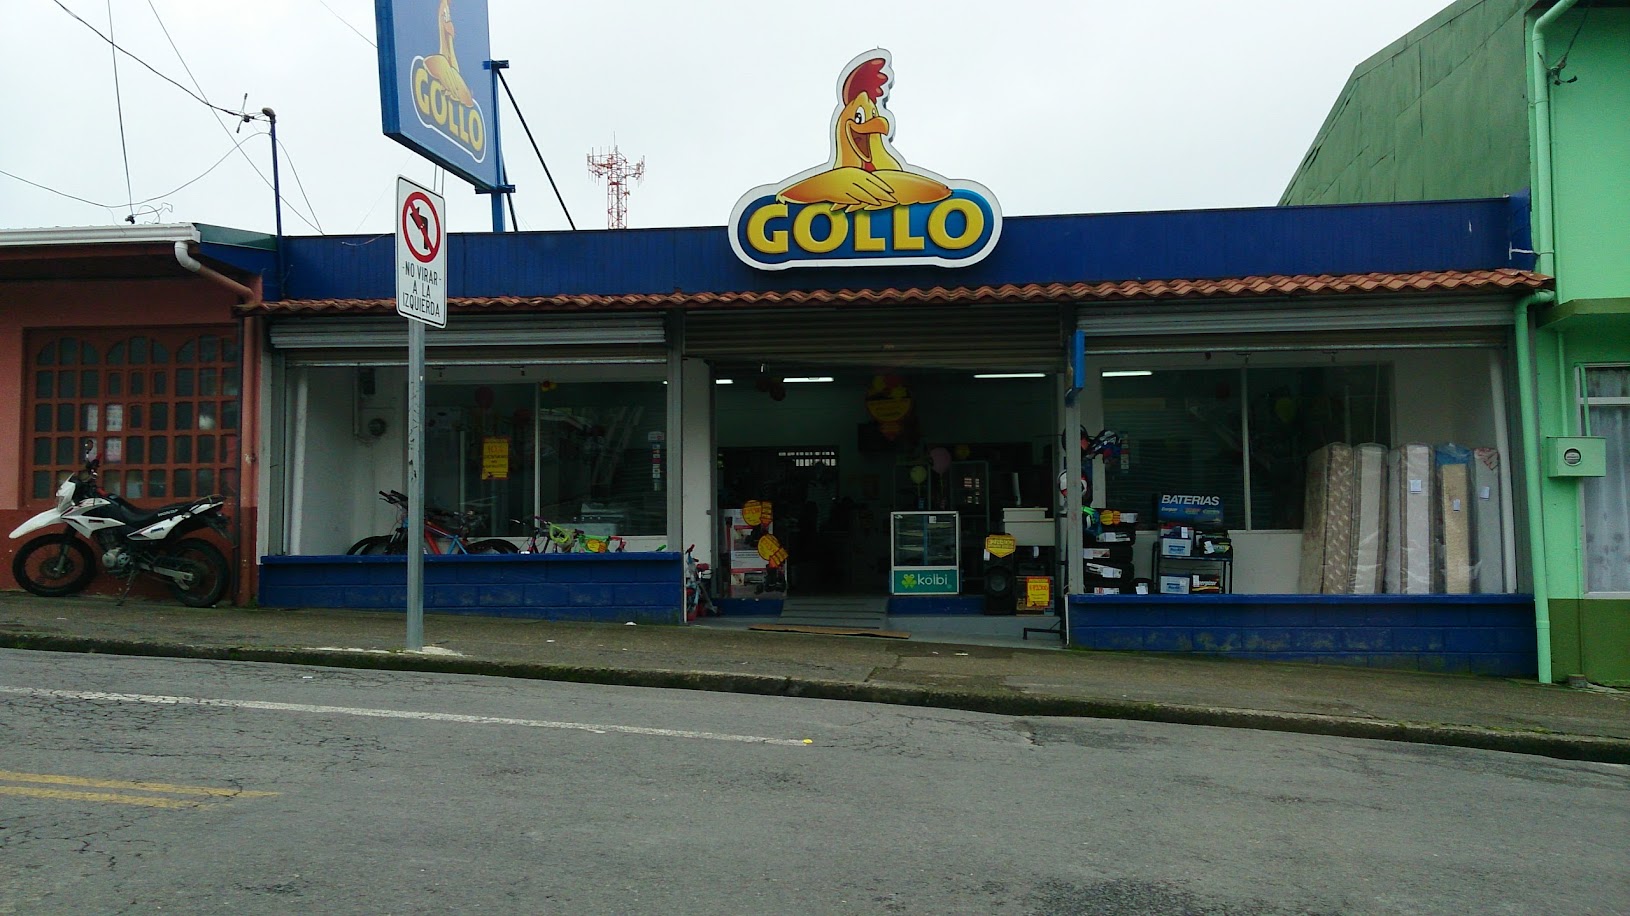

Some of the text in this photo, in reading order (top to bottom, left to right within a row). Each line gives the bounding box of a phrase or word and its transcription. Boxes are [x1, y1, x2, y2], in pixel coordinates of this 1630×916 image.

[415, 68, 484, 152] GOLLO
[746, 198, 985, 255] GOLLO
[412, 280, 431, 299] A LA
[402, 292, 440, 318] IZQUIERDA
[1161, 494, 1220, 506] BATERIAS
